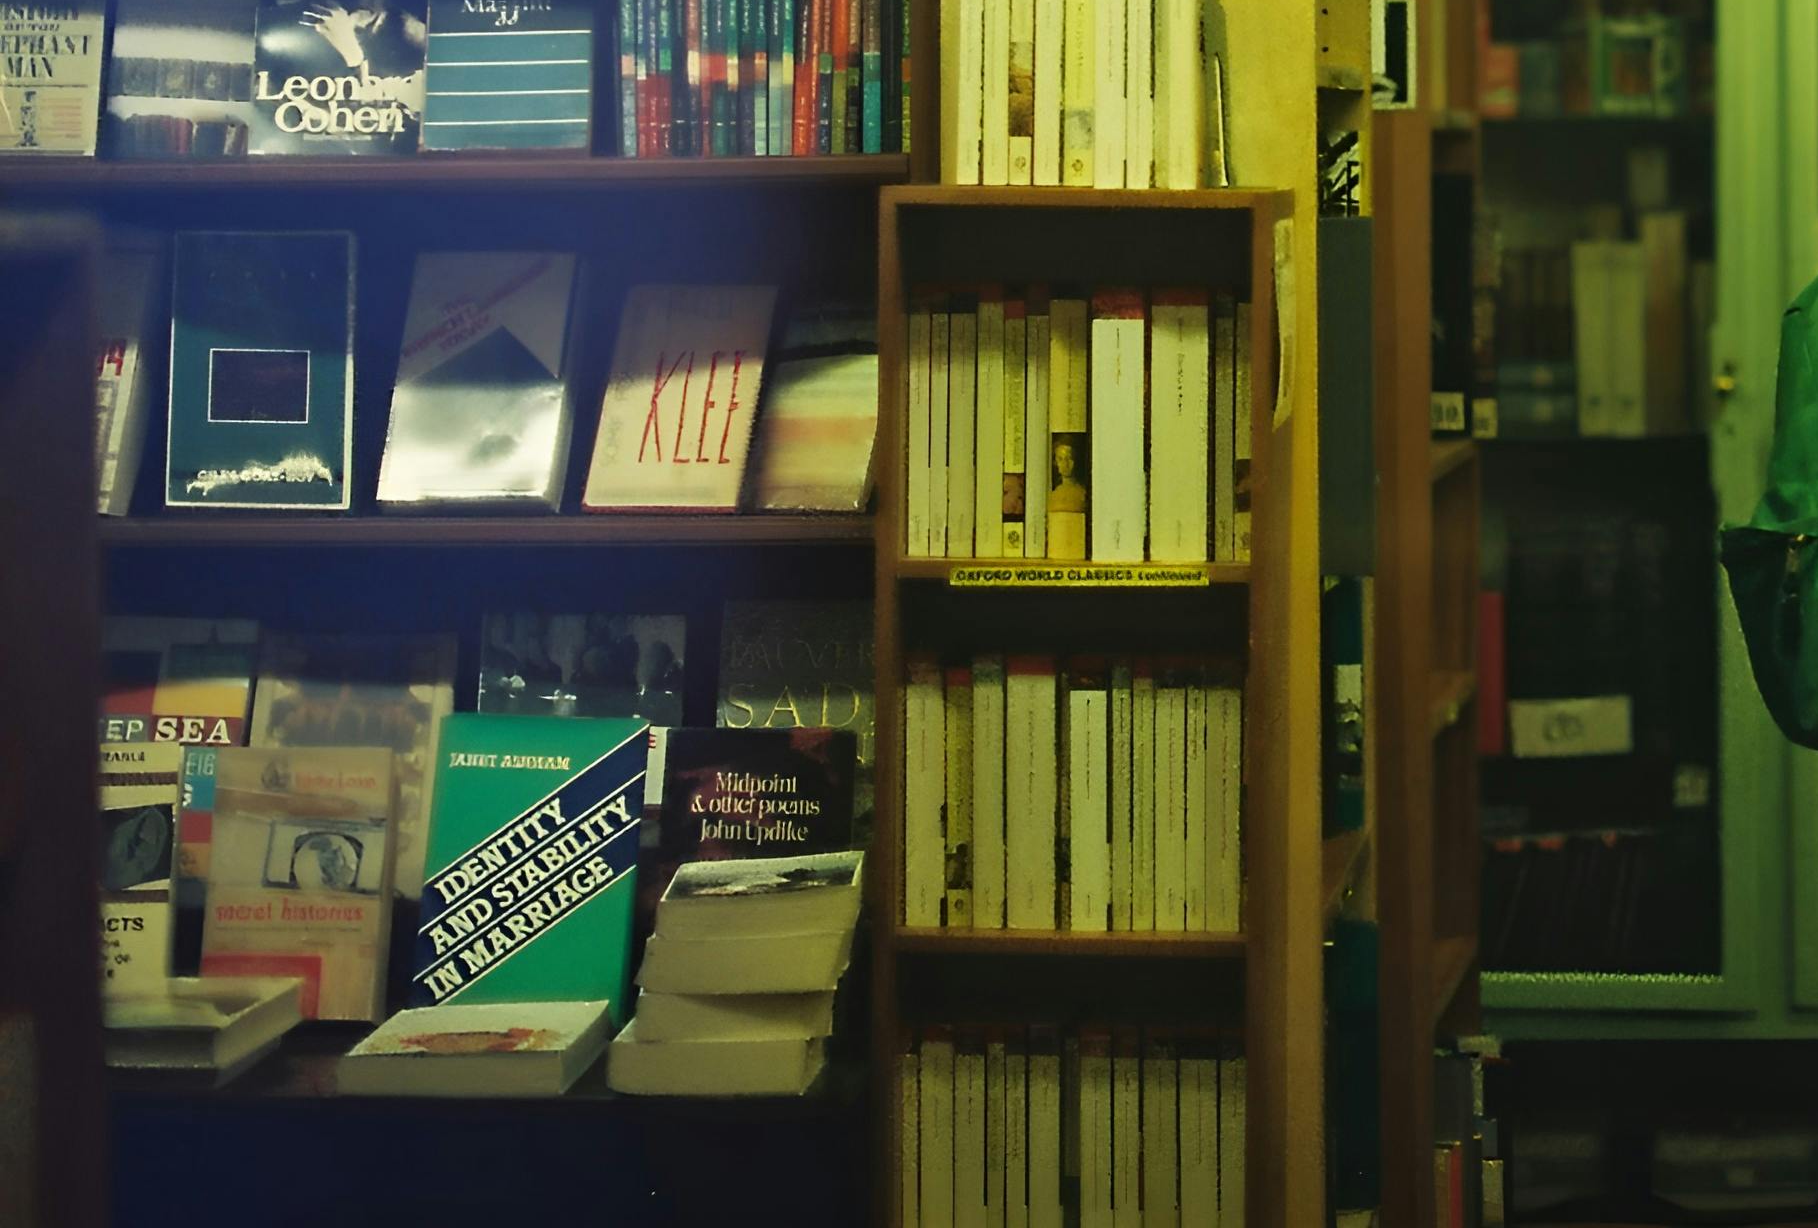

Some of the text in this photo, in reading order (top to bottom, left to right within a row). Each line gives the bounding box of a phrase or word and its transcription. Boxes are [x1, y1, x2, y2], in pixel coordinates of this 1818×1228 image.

[274, 101, 406, 134] Cohen
[638, 349, 748, 465] KLEE
[955, 569, 1011, 581] OXFORD
[1016, 569, 1064, 581] WORLD
[1067, 568, 1133, 581] CLASSICS
[105, 717, 232, 743] EP SEA
[449, 752, 498, 769] JANET
[716, 771, 797, 797] Midpoint
[690, 795, 821, 818] & other poems
[699, 818, 809, 846] John Updike
[434, 797, 567, 905] IDENTITY
[428, 794, 633, 956] AND STABILITY
[280, 896, 363, 923] histories
[105, 916, 145, 932] CTS
[423, 855, 615, 999] IN MARRIAGE
